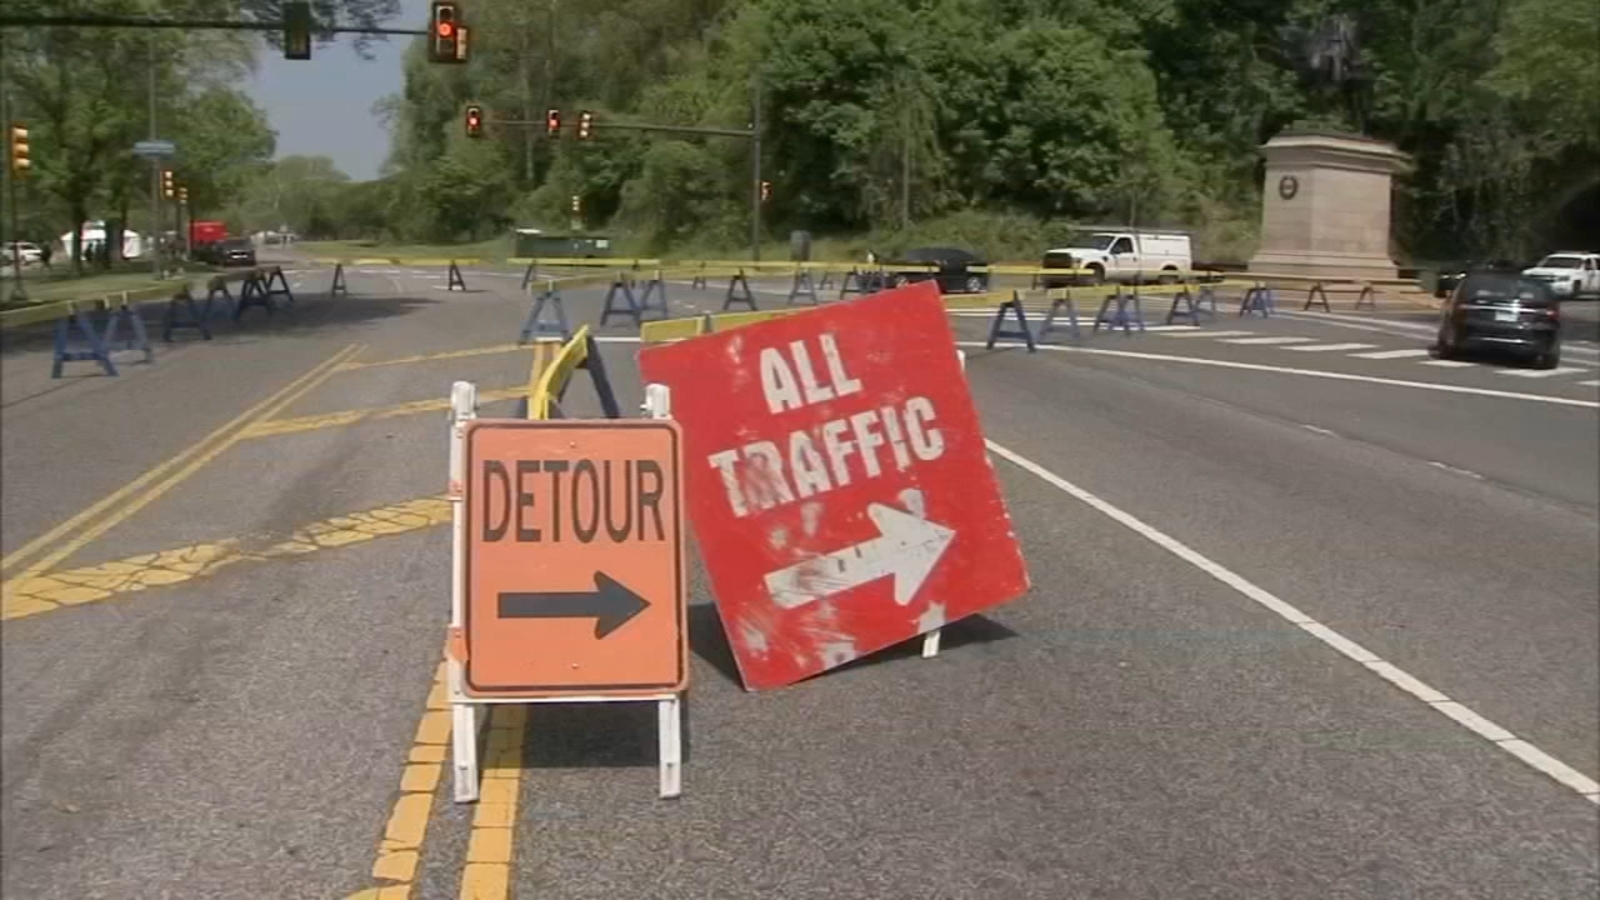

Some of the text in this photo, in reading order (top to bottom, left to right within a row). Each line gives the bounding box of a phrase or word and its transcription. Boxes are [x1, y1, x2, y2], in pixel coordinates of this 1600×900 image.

[760, 333, 862, 414] ALL
[708, 396, 944, 518] TRAFFIC
[482, 459, 666, 542] DETOUR
